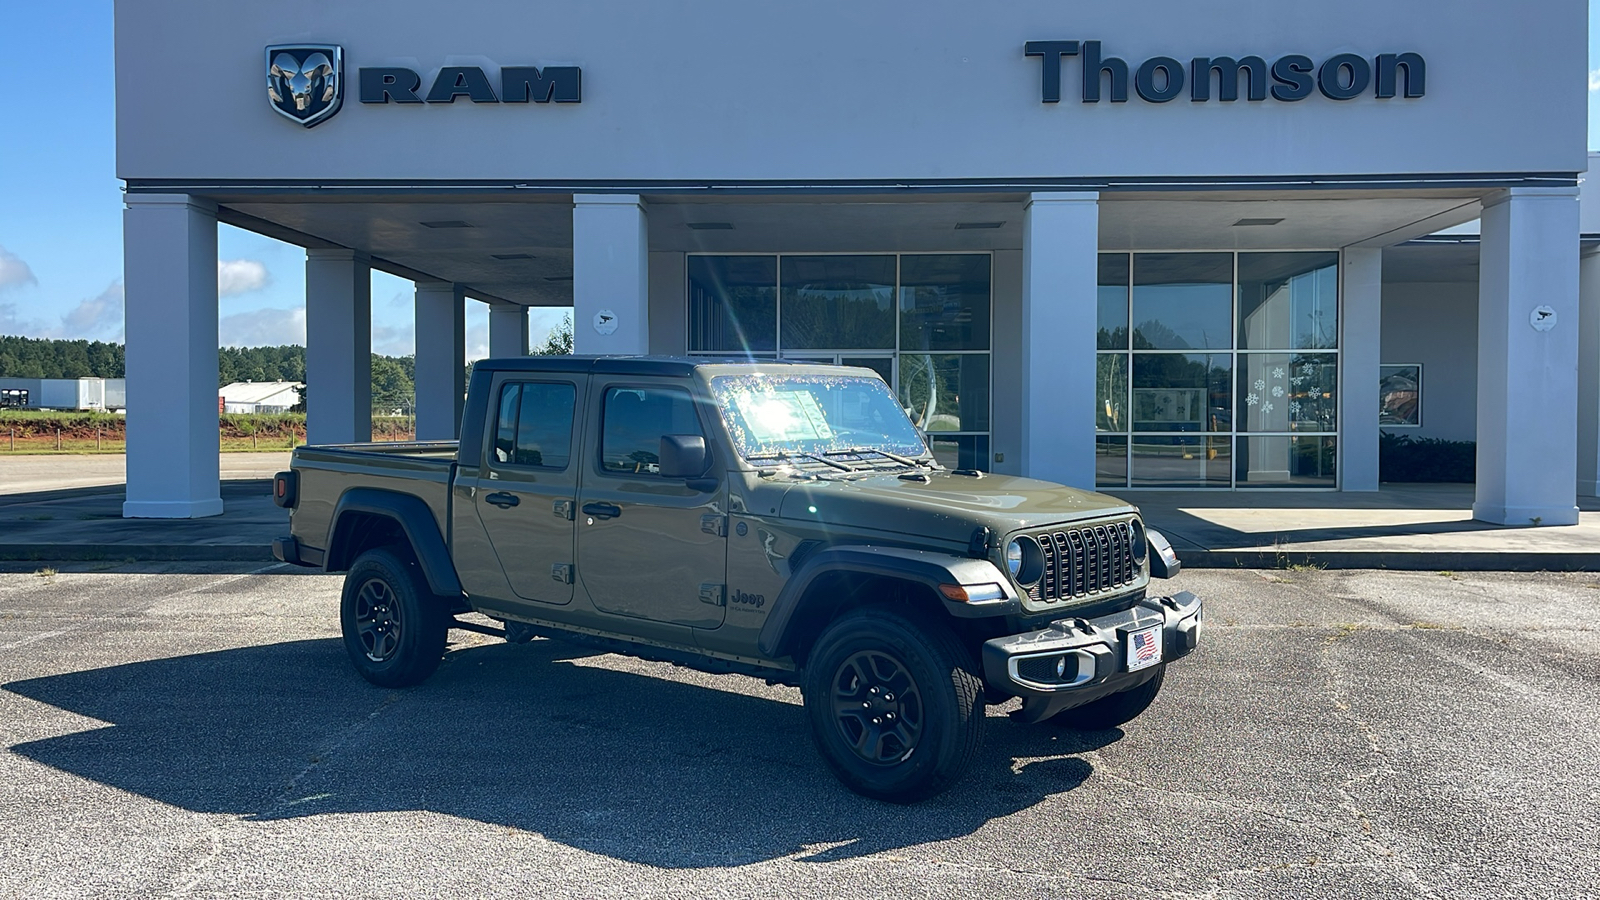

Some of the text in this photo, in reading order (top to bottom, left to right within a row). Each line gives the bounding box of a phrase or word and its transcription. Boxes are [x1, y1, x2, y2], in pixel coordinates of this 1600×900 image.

[358, 66, 582, 104] RAM
[1024, 40, 1428, 104] Thomson
[731, 589, 765, 608] Jeep
